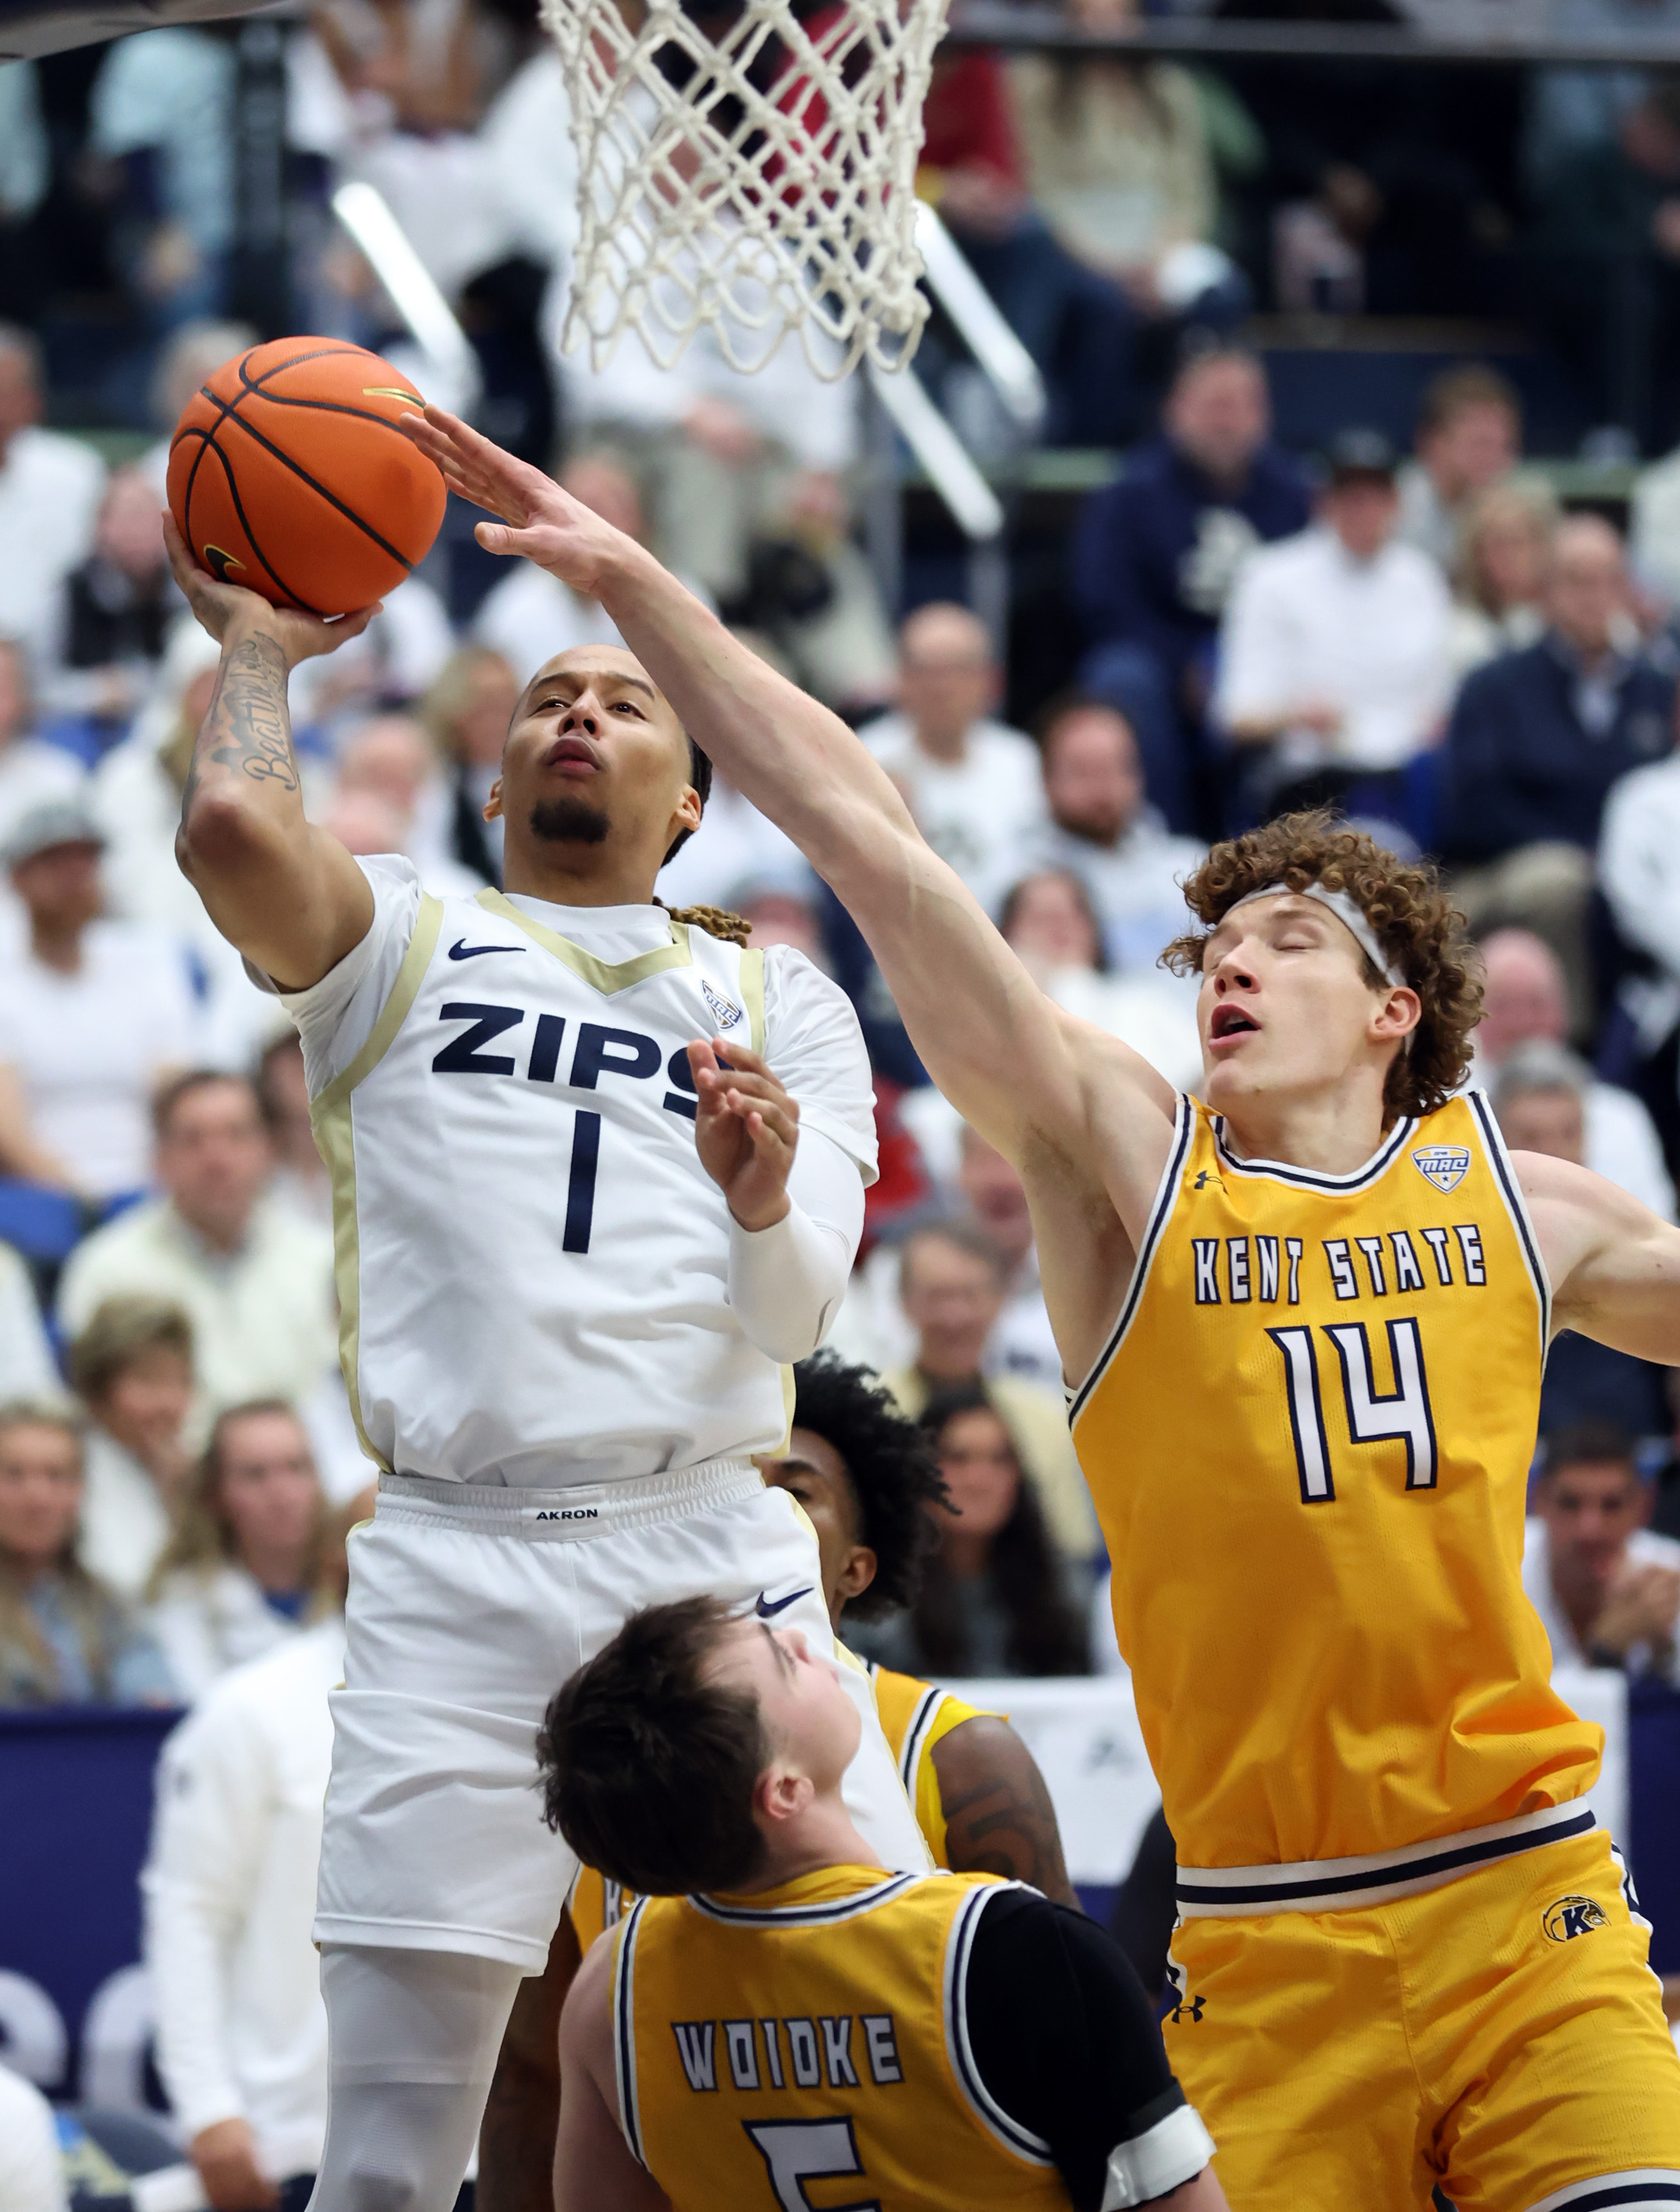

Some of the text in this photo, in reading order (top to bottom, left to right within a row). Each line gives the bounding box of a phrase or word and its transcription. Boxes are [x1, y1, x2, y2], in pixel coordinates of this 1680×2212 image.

[562, 1110, 601, 1254] 1
[1417, 1158, 1467, 1172] MAC
[1191, 1224, 1486, 1305] KENT STATE
[1264, 1316, 1438, 1504] 14
[536, 1508, 598, 1521] AKRON
[670, 2013, 905, 2093] WOIDKE
